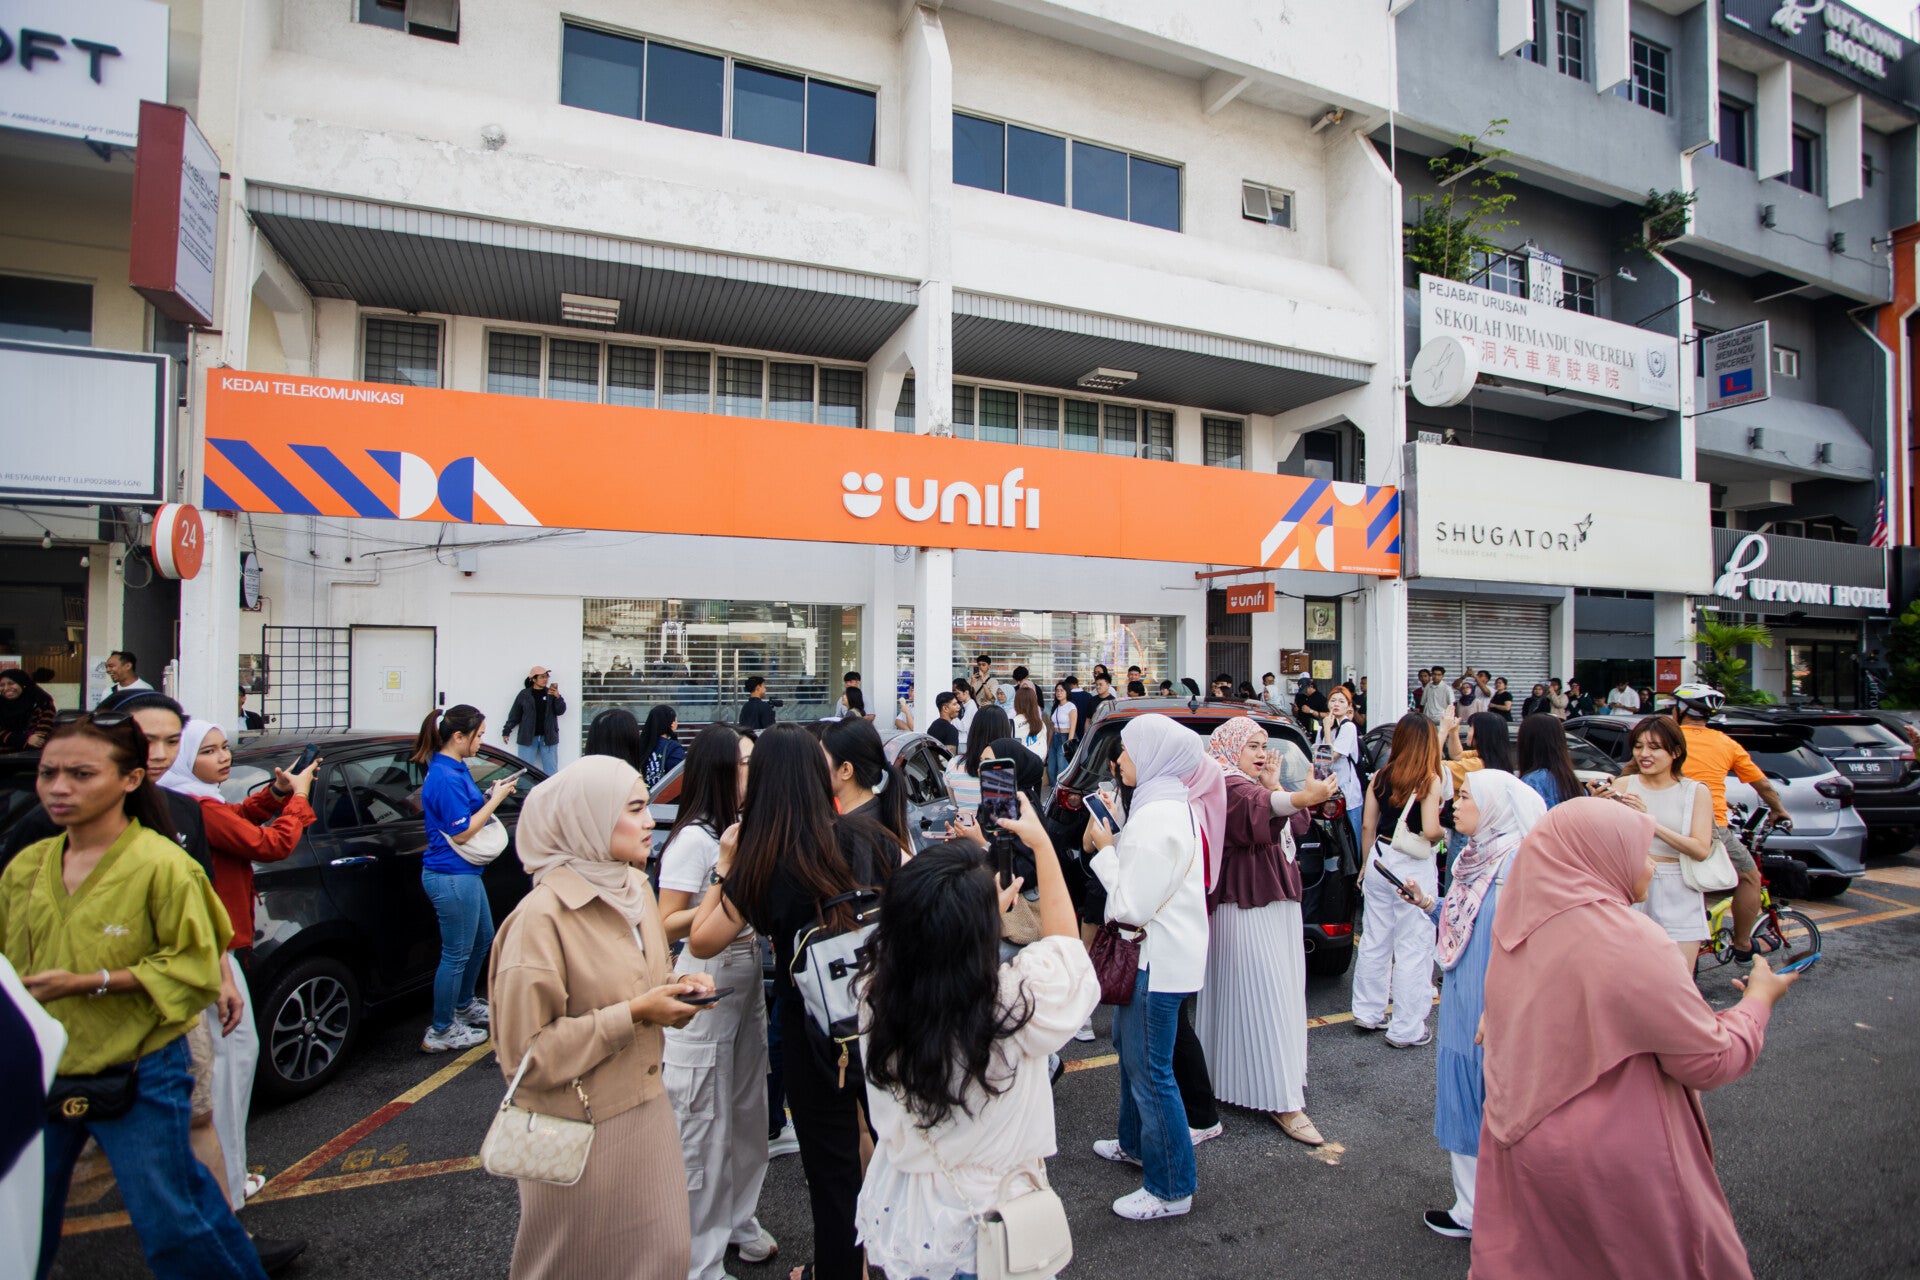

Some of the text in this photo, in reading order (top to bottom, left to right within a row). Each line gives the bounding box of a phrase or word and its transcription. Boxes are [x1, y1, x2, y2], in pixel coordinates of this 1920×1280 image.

[1824, 2, 1902, 62] UPTOWN
[0, 27, 122, 85] FT
[1825, 29, 1887, 79] HOTEL
[1429, 281, 1528, 317] PEJABAT URUSAN
[1434, 306, 1636, 369] SEKOLAH MEMANDU SINCERELY
[1716, 334, 1753, 351] SEKOLAH
[1716, 344, 1754, 360] MEMANDU
[1461, 335, 1620, 390] 洞汽車駕駛學院
[1714, 354, 1756, 371] SINCERELY
[222, 377, 405, 405] KEDAI TELEKOMUNIKASI
[1419, 433, 1442, 444] KAFE
[5, 473, 57, 482] RESTAURANT
[895, 467, 1041, 529] unifi
[180, 520, 197, 549] 24
[1436, 521, 1578, 552] SHUGATORI
[1238, 590, 1265, 607] unifi
[1749, 578, 1832, 605] UPTOWN
[1833, 585, 1891, 609] HOTEL
[1848, 763, 1881, 772] VHK 915
